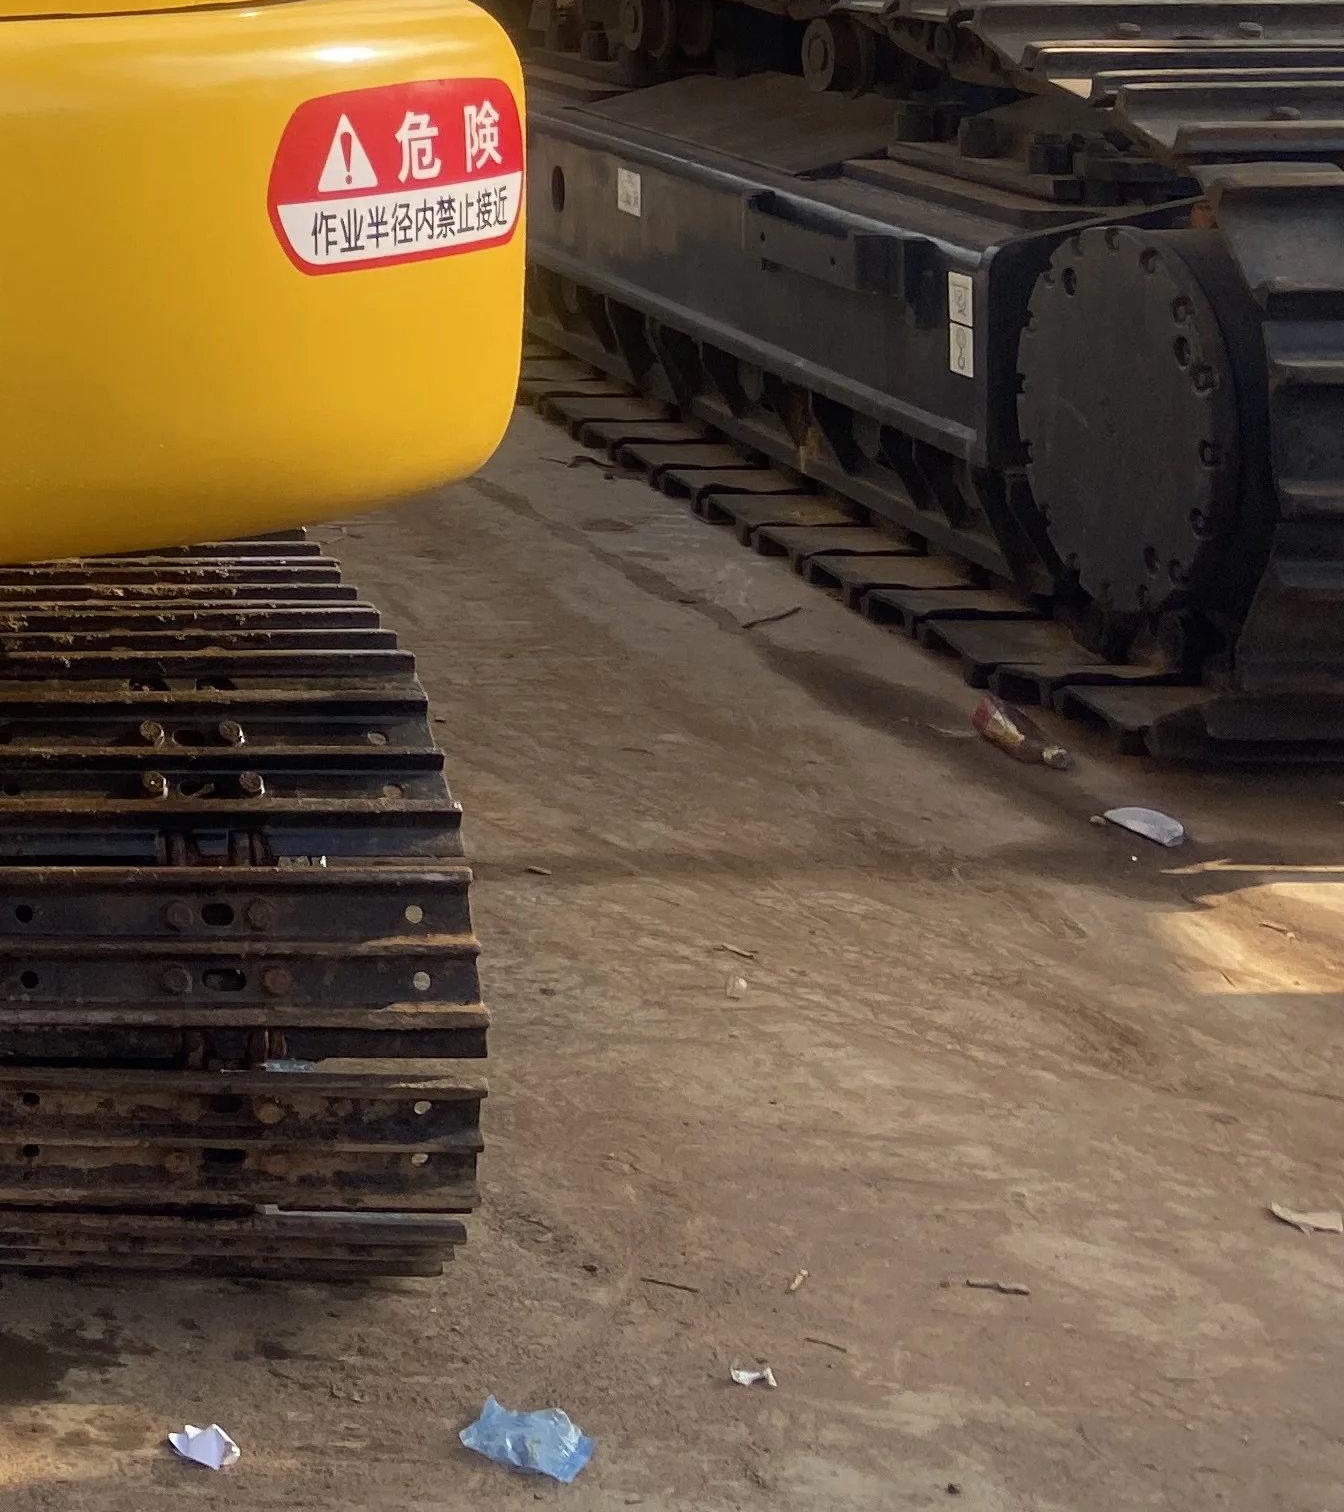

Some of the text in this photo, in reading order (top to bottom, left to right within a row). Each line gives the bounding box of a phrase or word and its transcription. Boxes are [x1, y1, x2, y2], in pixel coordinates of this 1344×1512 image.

[311, 186, 508, 256] 作业半径内禁止接近
